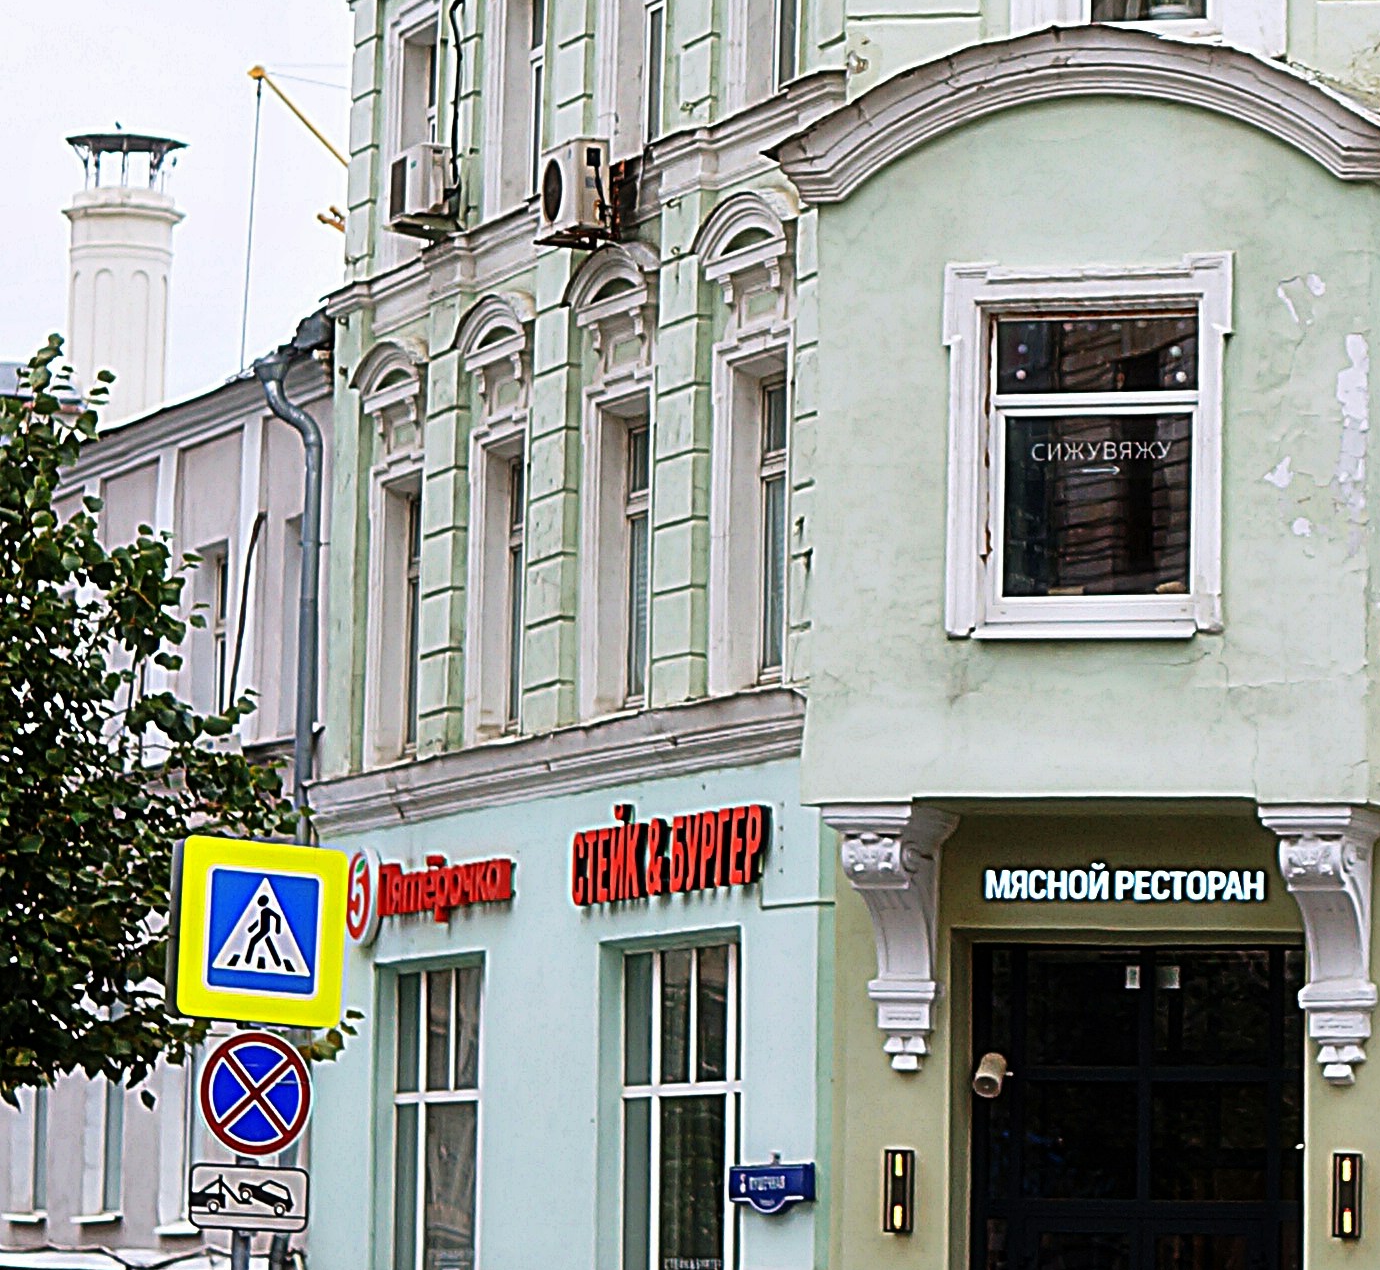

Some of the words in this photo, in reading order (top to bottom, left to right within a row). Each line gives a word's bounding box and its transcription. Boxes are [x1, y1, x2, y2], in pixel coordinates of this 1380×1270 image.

[1031, 441, 1172, 462] СИЖУВЯЖУ
[572, 804, 641, 906] СТЕЙК
[646, 818, 663, 896] &
[669, 804, 764, 893] БУРГЕР
[985, 861, 1109, 901] МЯСНОЙ
[1114, 870, 1265, 901] РЕСТОРАН
